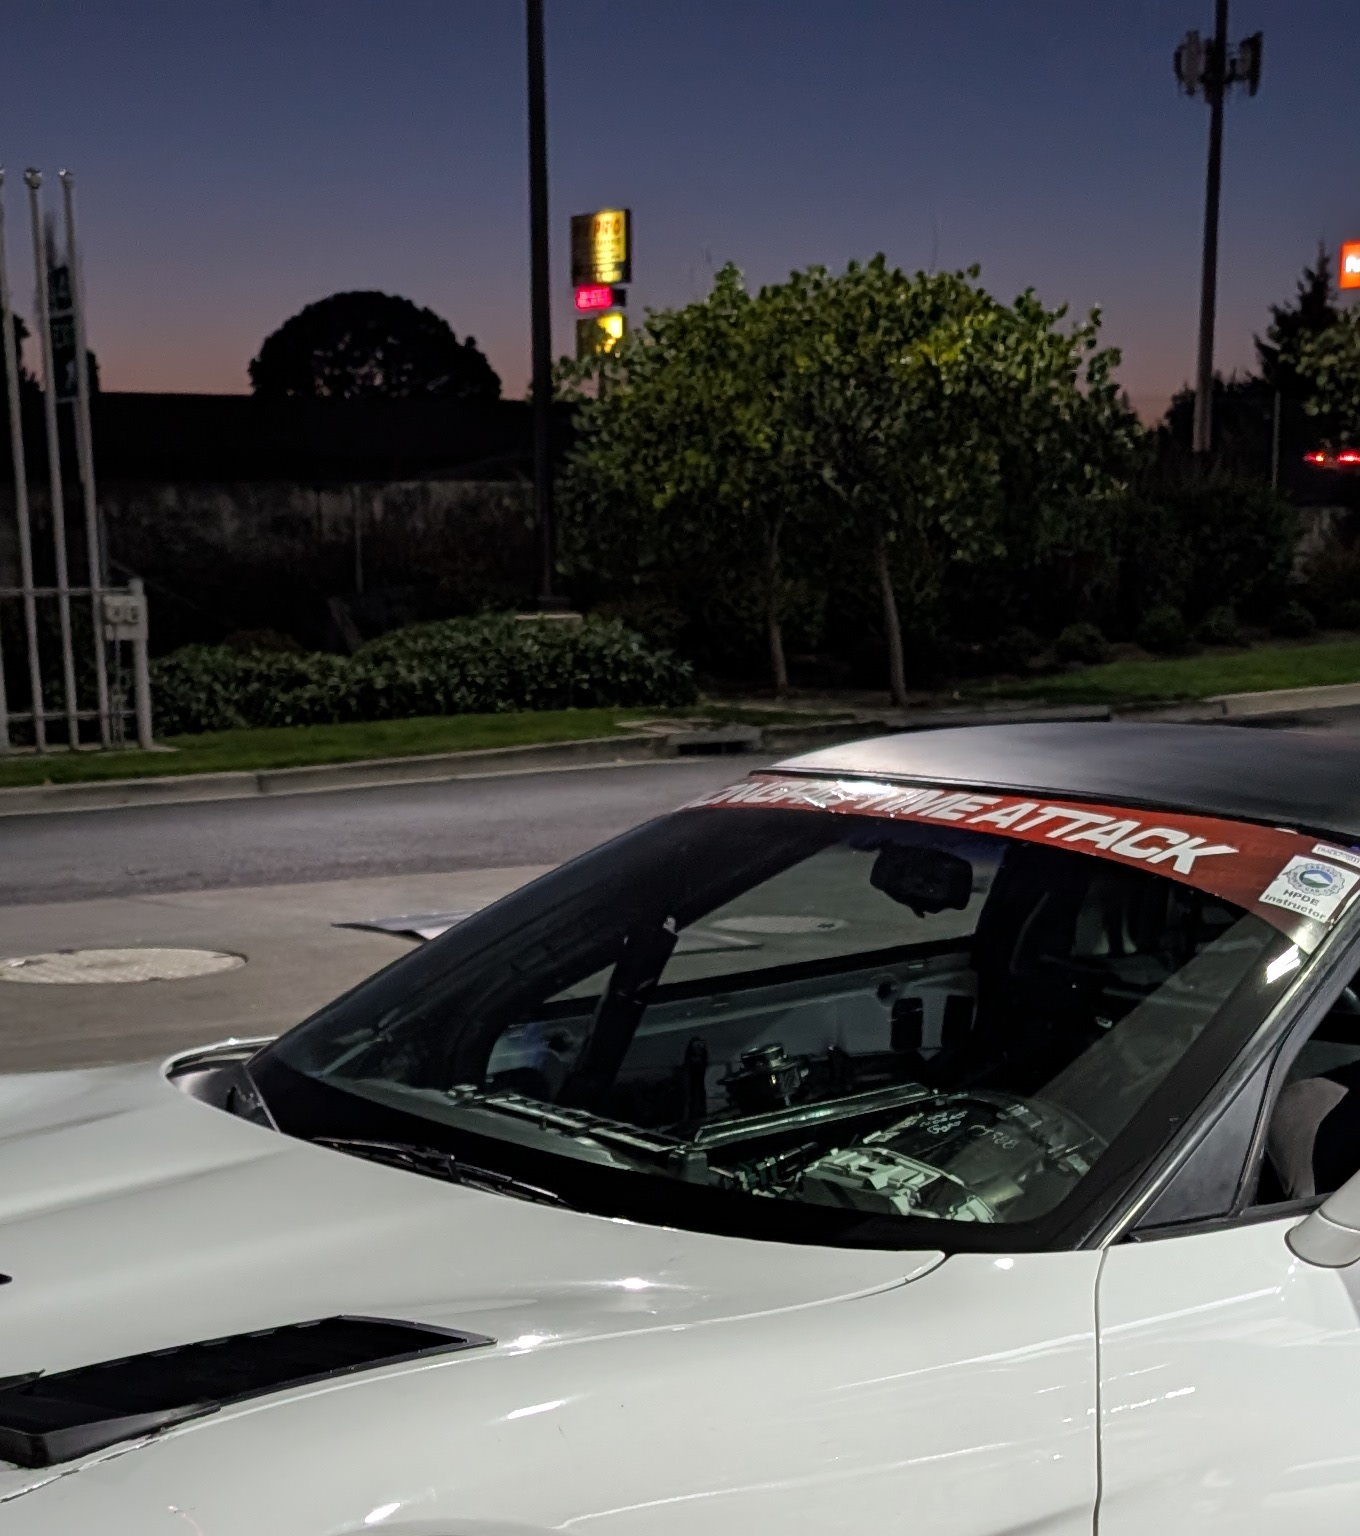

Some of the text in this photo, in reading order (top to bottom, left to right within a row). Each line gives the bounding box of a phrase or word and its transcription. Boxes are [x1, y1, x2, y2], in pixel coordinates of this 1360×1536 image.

[966, 802, 1239, 875] ATTACK
[1263, 894, 1327, 920] Instructor
[1282, 889, 1320, 907] HPDE
